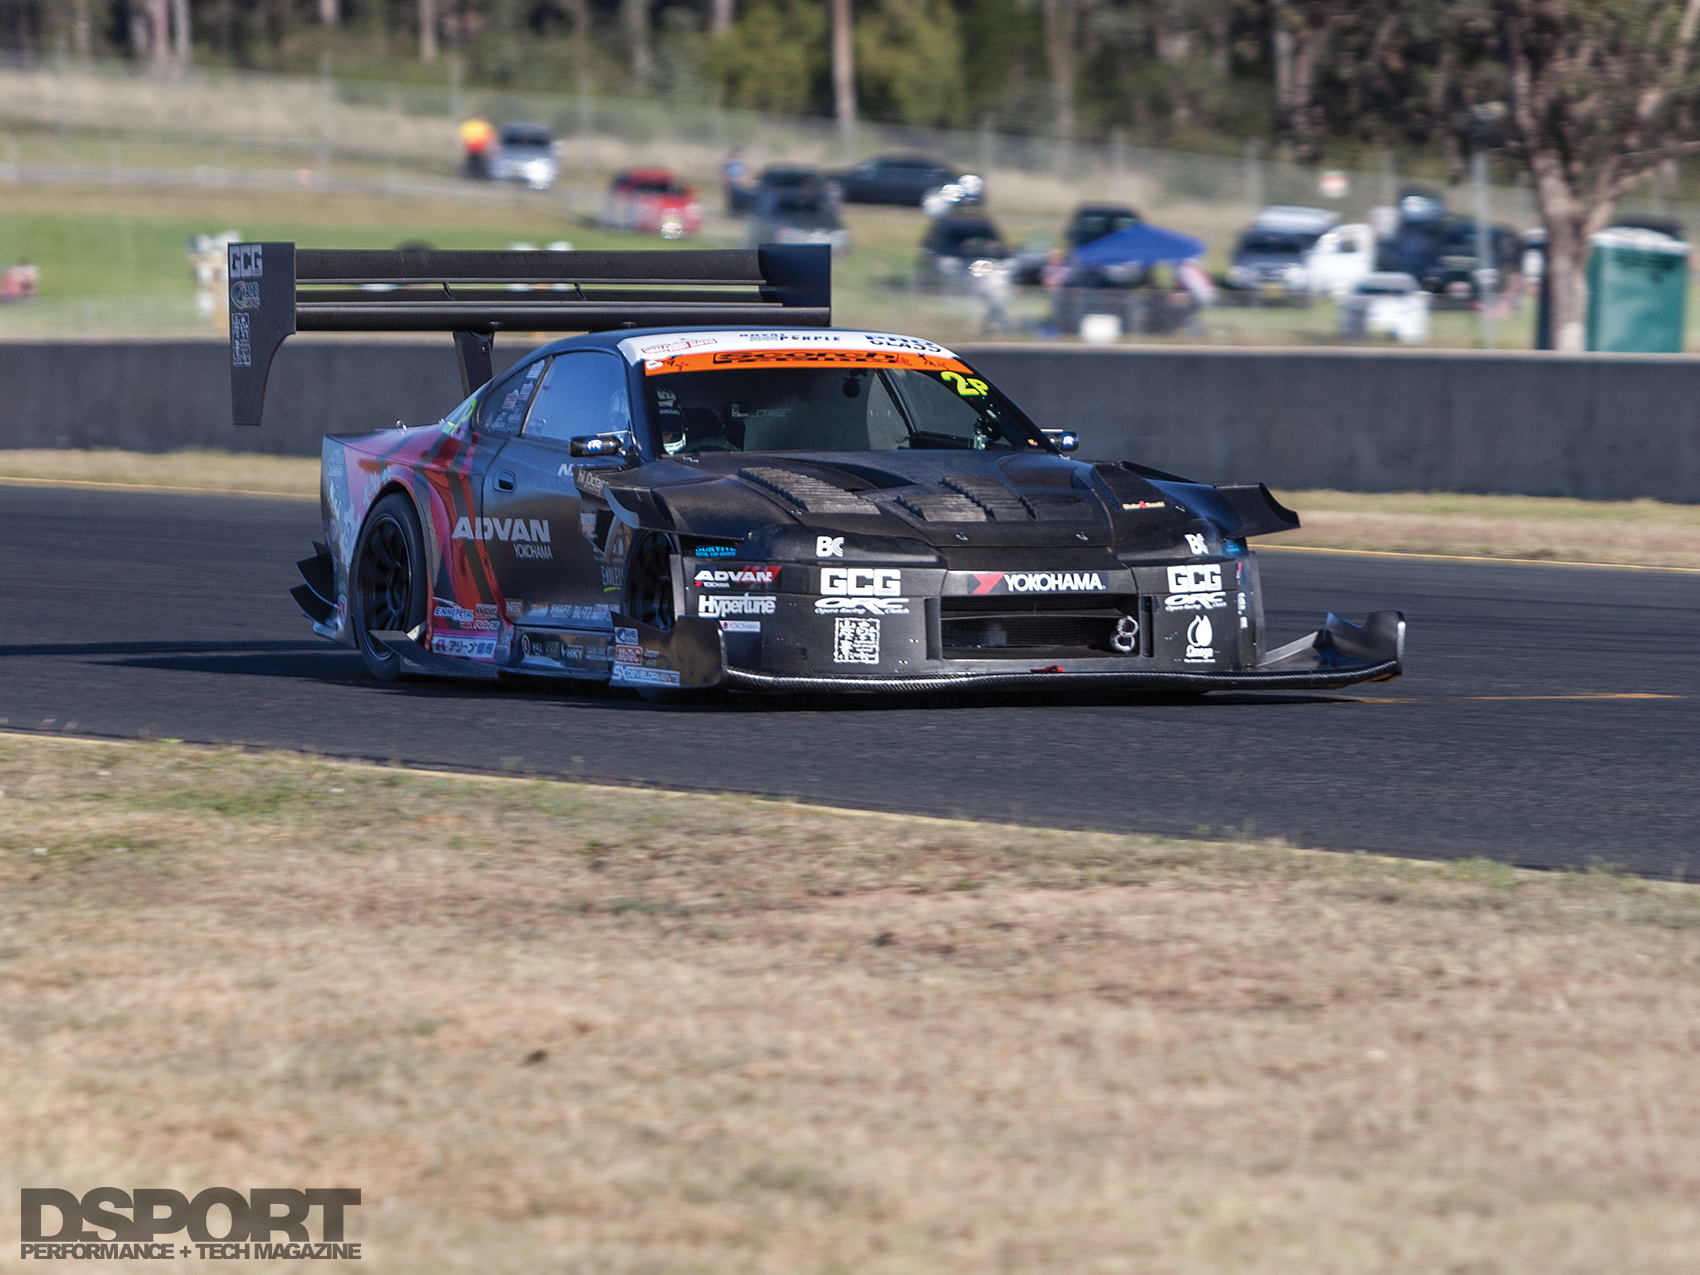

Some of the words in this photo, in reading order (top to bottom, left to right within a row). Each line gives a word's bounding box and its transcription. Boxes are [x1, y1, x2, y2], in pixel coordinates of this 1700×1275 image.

[451, 516, 551, 543] ADVAN
[513, 543, 553, 560] YOKOHAMA
[816, 536, 845, 558] BC
[694, 570, 773, 582] ADVAN
[820, 568, 901, 596] GCG
[1003, 573, 1103, 592] YOKOHAMA
[1167, 564, 1222, 593] GCG
[698, 592, 777, 617] Hypertune
